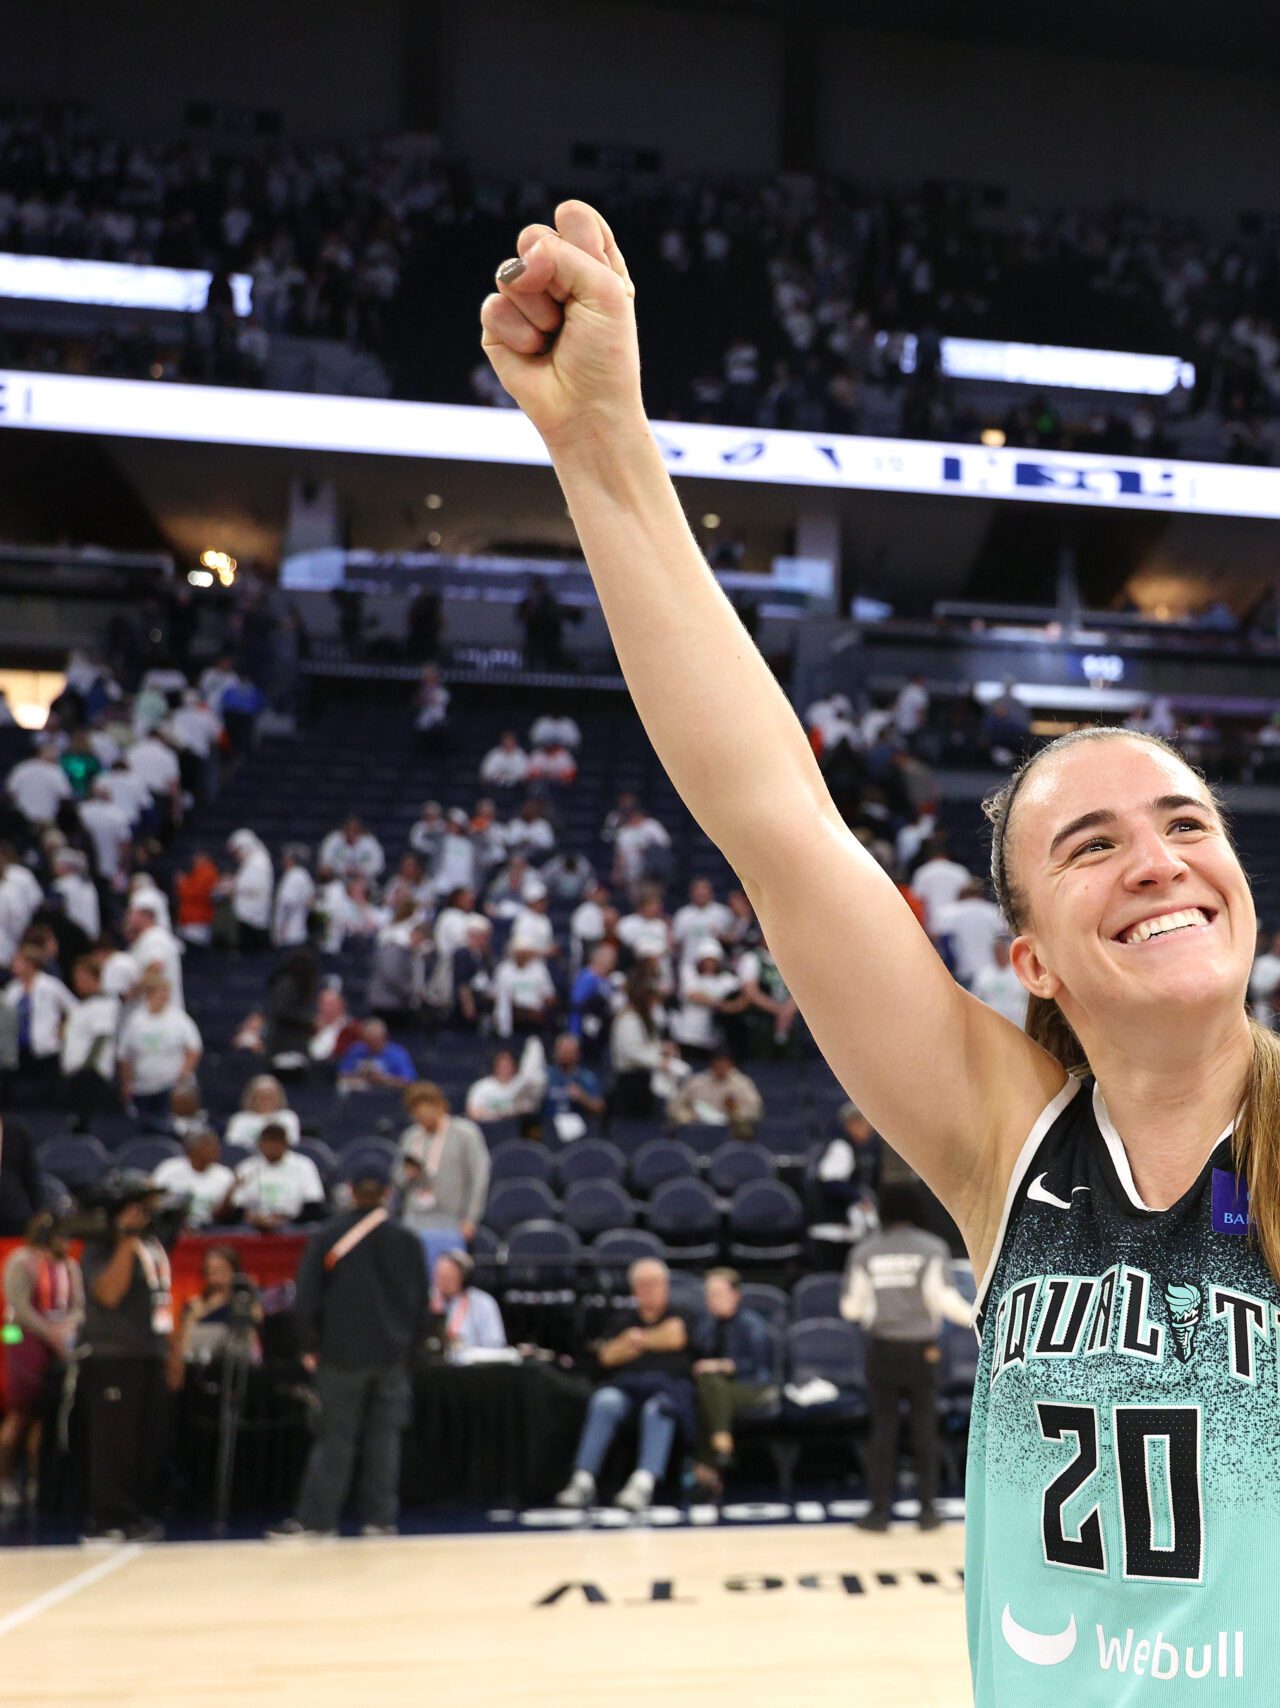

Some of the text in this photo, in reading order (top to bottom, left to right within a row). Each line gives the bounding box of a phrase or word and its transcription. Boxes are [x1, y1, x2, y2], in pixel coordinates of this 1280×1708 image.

[1224, 1212, 1249, 1225] BA
[1035, 1401, 1203, 1583] 20
[1096, 1624, 1244, 1680] Webull
